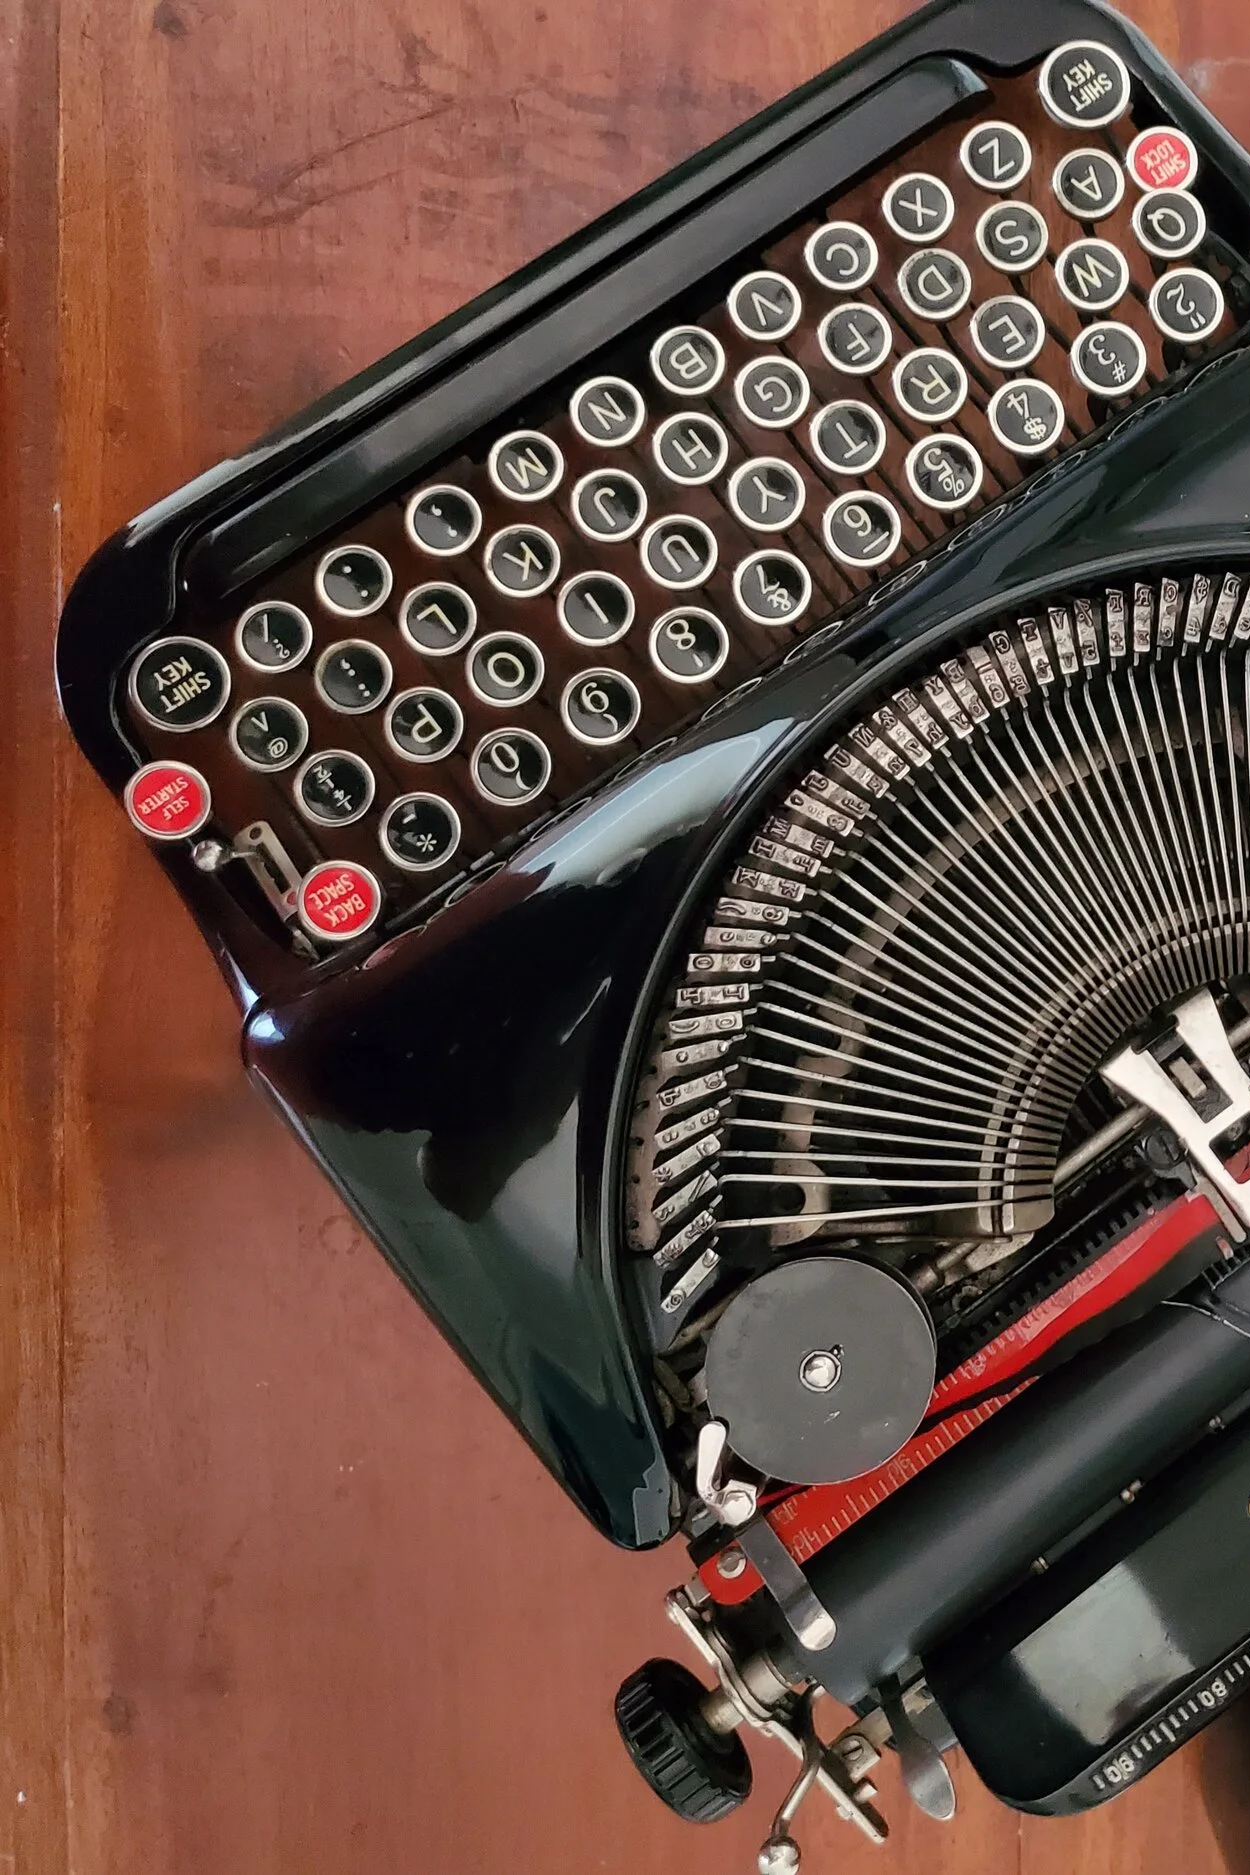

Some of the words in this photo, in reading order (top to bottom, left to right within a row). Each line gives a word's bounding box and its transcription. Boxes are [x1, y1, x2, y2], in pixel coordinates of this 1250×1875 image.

[1062, 58, 1098, 93] KEY
[1070, 71, 1114, 113] SHIFT
[978, 137, 1016, 179] Z
[1140, 139, 1174, 166] LOCK
[1152, 153, 1188, 185] SHIFT
[1070, 163, 1102, 201] A
[898, 187, 938, 227] X
[1146, 206, 1187, 243] Q
[994, 219, 1029, 257] S
[825, 242, 860, 276] C
[1072, 252, 1116, 298] W
[917, 263, 954, 302] D
[1166, 283, 1197, 315] 2
[750, 290, 784, 327] V
[846, 322, 872, 362] F
[988, 314, 1027, 355] E
[1088, 333, 1116, 366] 3
[669, 342, 708, 380] B
[1111, 362, 1128, 384] #
[754, 375, 793, 413] G
[909, 364, 951, 406] R
[587, 391, 628, 431] N
[1006, 392, 1031, 419] 4
[834, 421, 869, 460] T
[1022, 416, 1047, 442] $
[671, 428, 713, 471] H
[923, 447, 952, 481] 5
[505, 447, 550, 490] M
[752, 475, 787, 515] Y
[942, 477, 965, 498] %
[593, 486, 617, 528] J
[843, 505, 873, 537] 6
[502, 541, 545, 582] K
[660, 533, 701, 574] U
[756, 564, 781, 595] 7
[766, 588, 793, 612] &
[417, 603, 458, 635] L
[666, 619, 697, 651] 8
[273, 638, 291, 660] ?
[155, 656, 193, 692] KEY
[487, 651, 526, 688] O
[163, 665, 212, 714] SHIFT
[580, 682, 610, 713] 9
[410, 703, 444, 743] P
[268, 737, 288, 758] @
[138, 775, 189, 816] STARTER
[162, 795, 190, 820] SELF
[308, 872, 355, 910] SPACE
[324, 894, 366, 928] BACK
